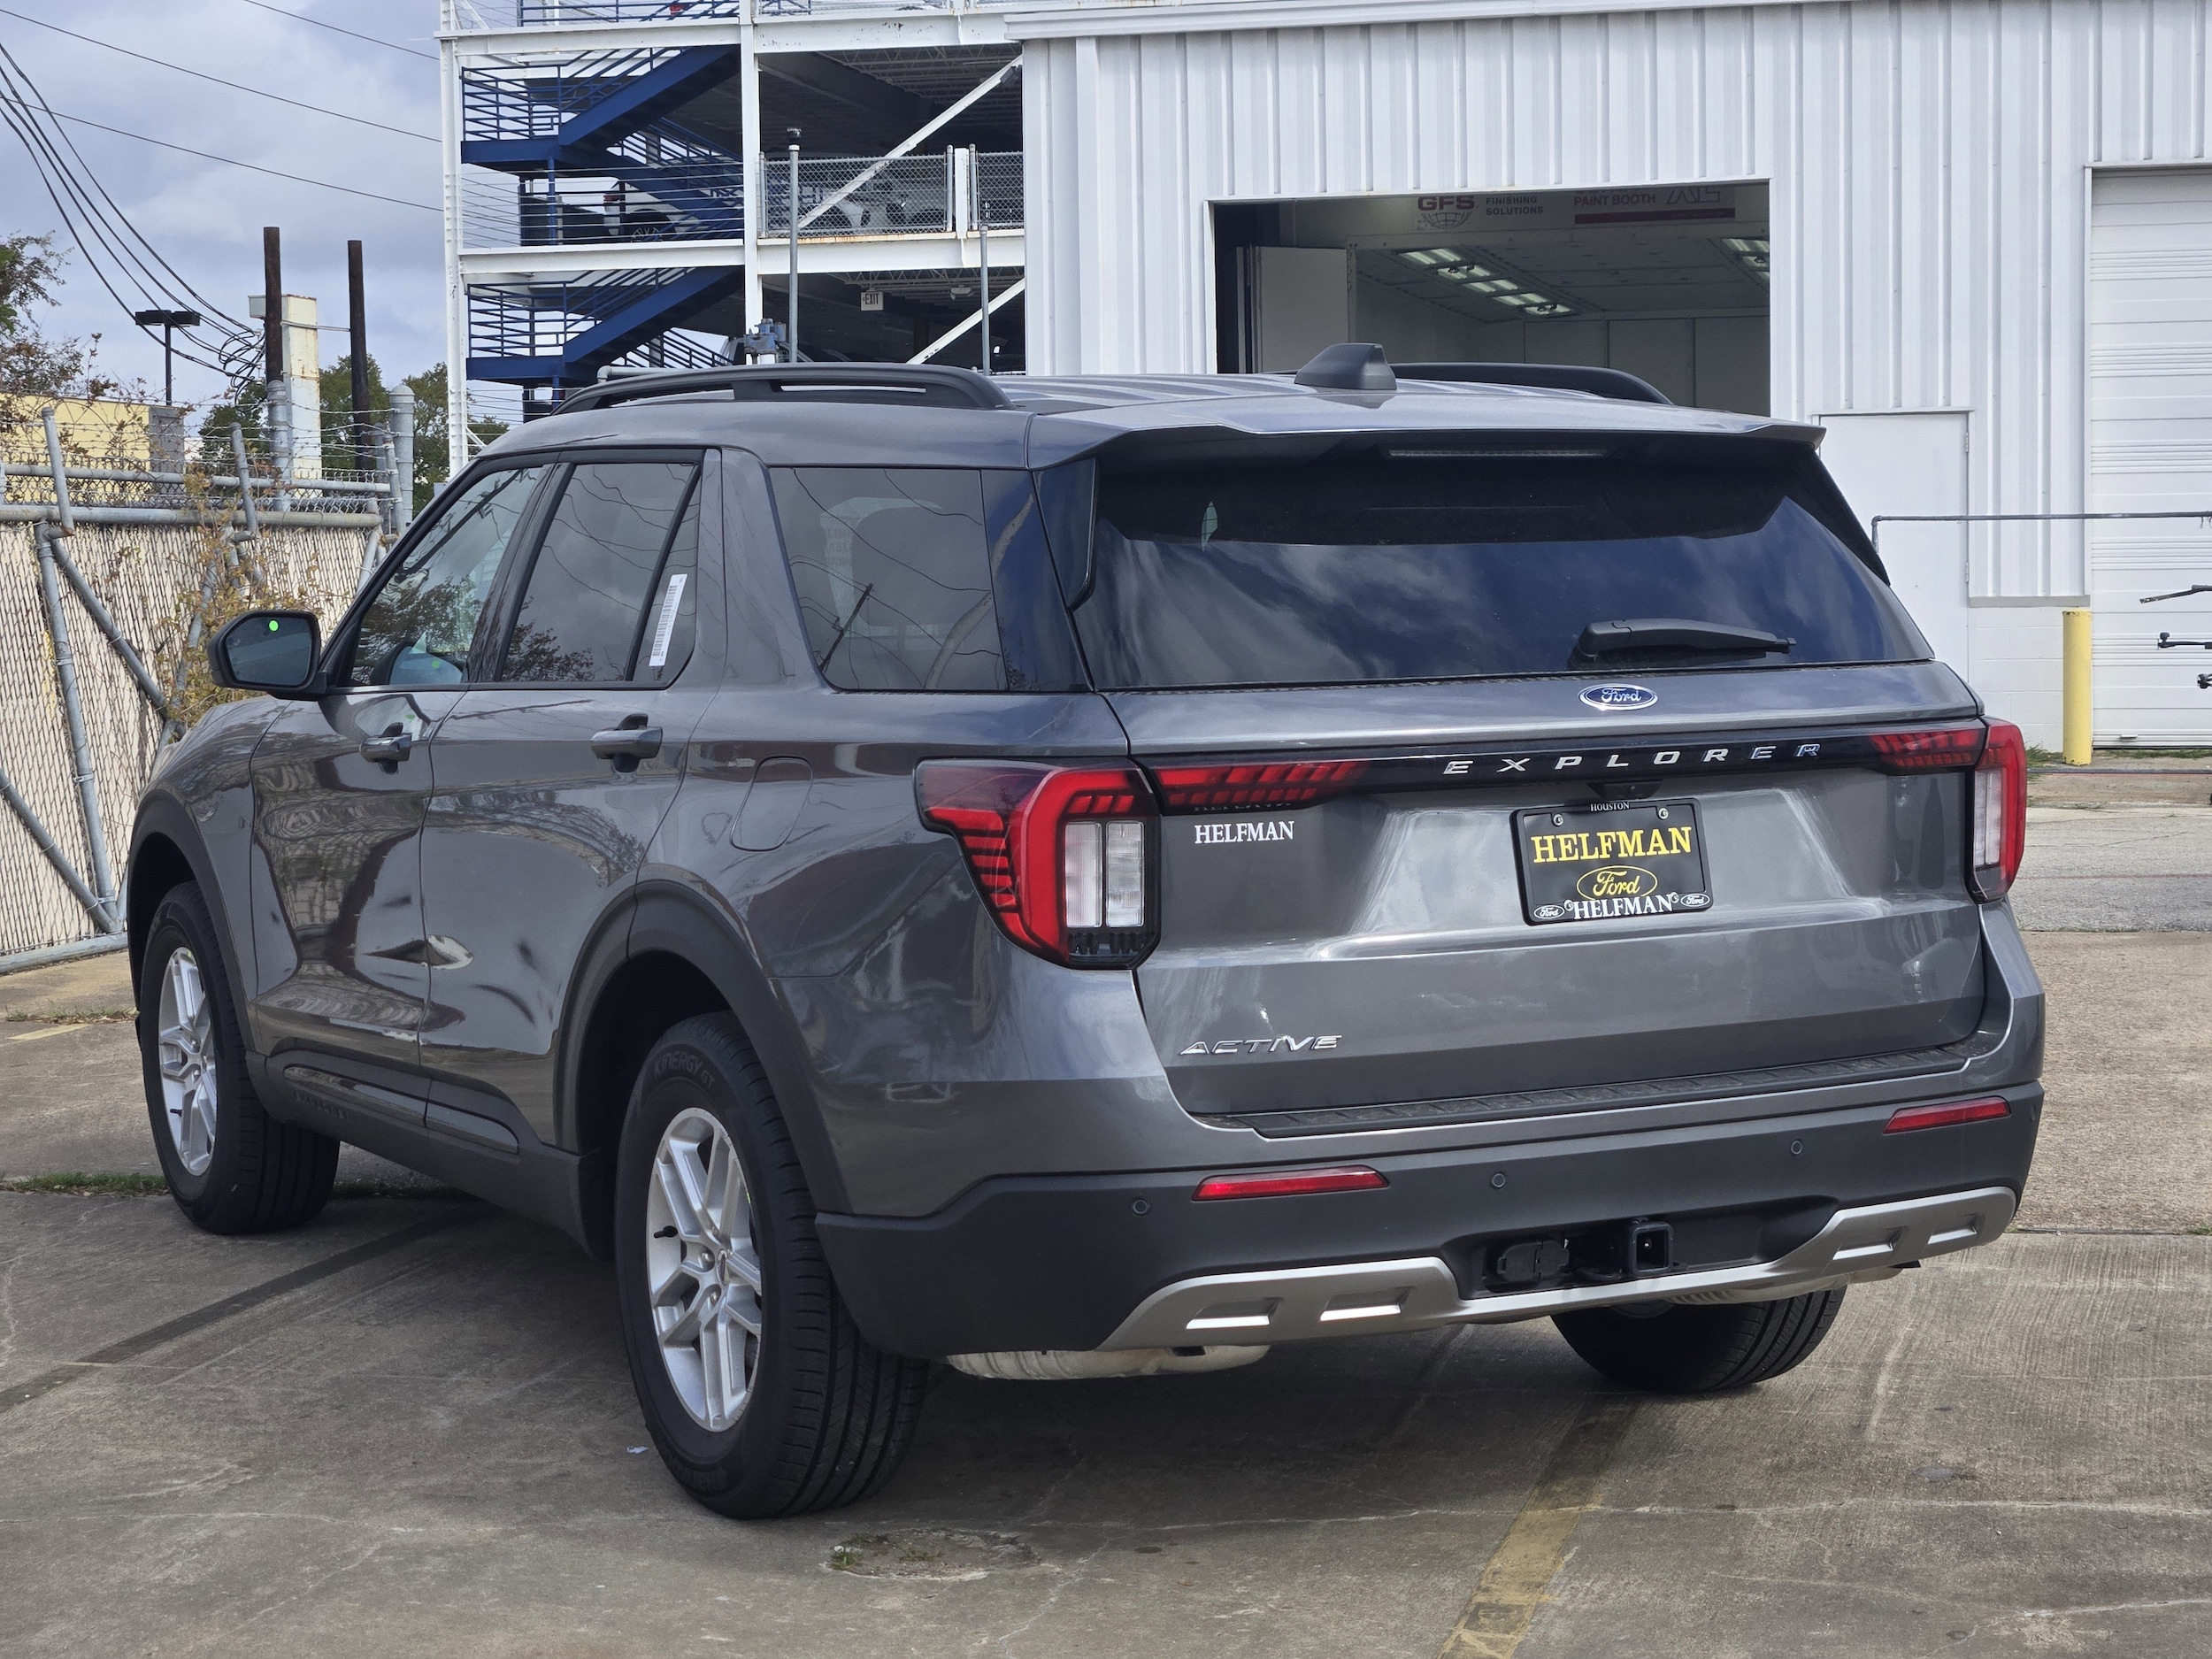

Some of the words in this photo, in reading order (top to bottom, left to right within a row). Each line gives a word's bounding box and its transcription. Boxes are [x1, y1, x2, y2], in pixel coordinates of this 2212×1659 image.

[1417, 195, 1476, 211] GFS
[1486, 196, 1538, 205] FINISHING
[1574, 195, 1609, 207] PAINT
[1612, 193, 1656, 205] BOOTH
[1486, 206, 1544, 216] SOLUTIONS
[864, 293, 879, 305] EXIT
[1442, 743, 1822, 776] EXPLORER
[1590, 802, 1630, 811] HOUSTON
[1194, 821, 1294, 844] HELFMAN
[1531, 826, 1693, 864] HELFMAN
[1593, 870, 1640, 896] Ford
[1573, 895, 1672, 920] HELFMAN
[1179, 1034, 1342, 1056] ACTIVE
